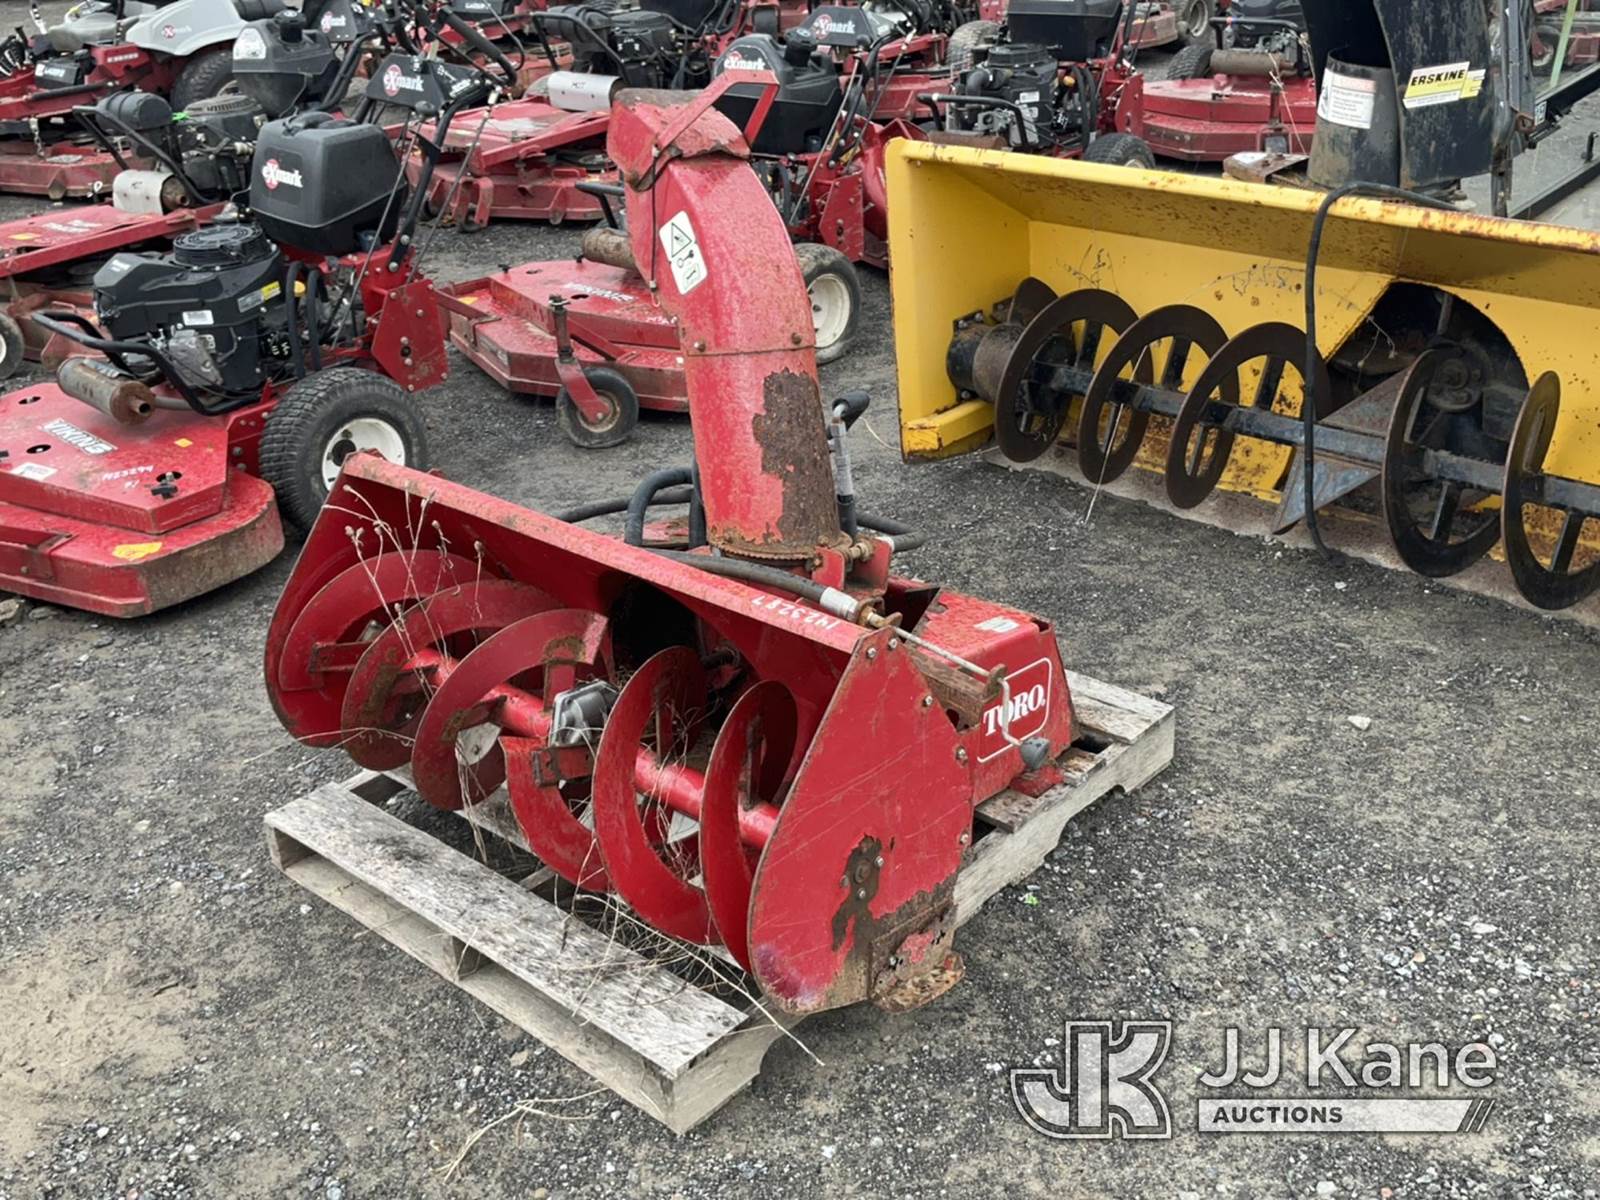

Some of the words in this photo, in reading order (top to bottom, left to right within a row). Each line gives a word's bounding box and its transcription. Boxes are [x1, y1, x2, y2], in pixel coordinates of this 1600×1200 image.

[1410, 68, 1466, 87] ERSKINE
[43, 420, 115, 455] VIKING
[983, 684, 1044, 736] TORO
